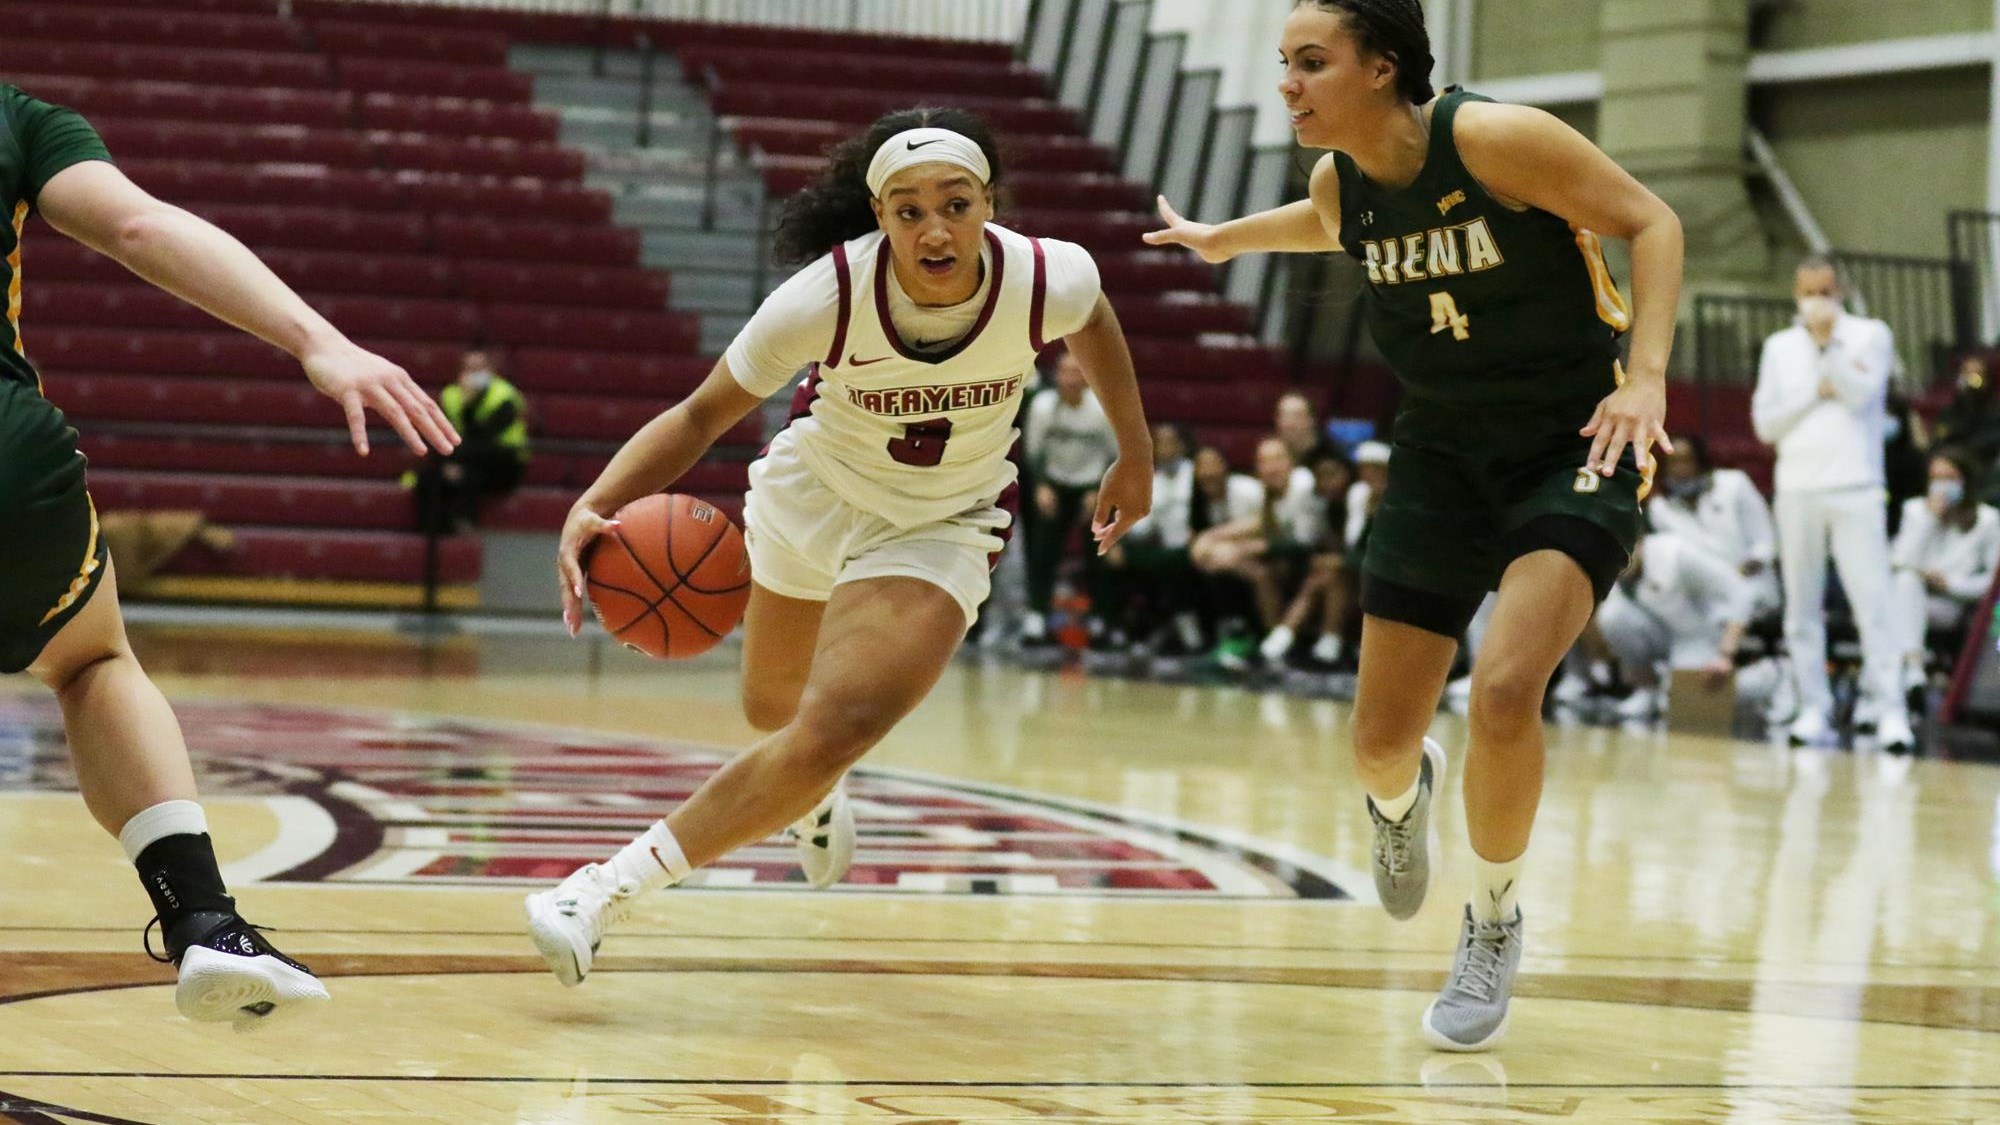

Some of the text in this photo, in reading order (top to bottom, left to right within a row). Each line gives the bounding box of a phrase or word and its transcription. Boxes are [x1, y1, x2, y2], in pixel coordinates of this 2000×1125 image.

[1428, 291, 1471, 341] 4
[845, 373, 1024, 417] LAFAYETTE
[156, 876, 180, 909] CURRY
